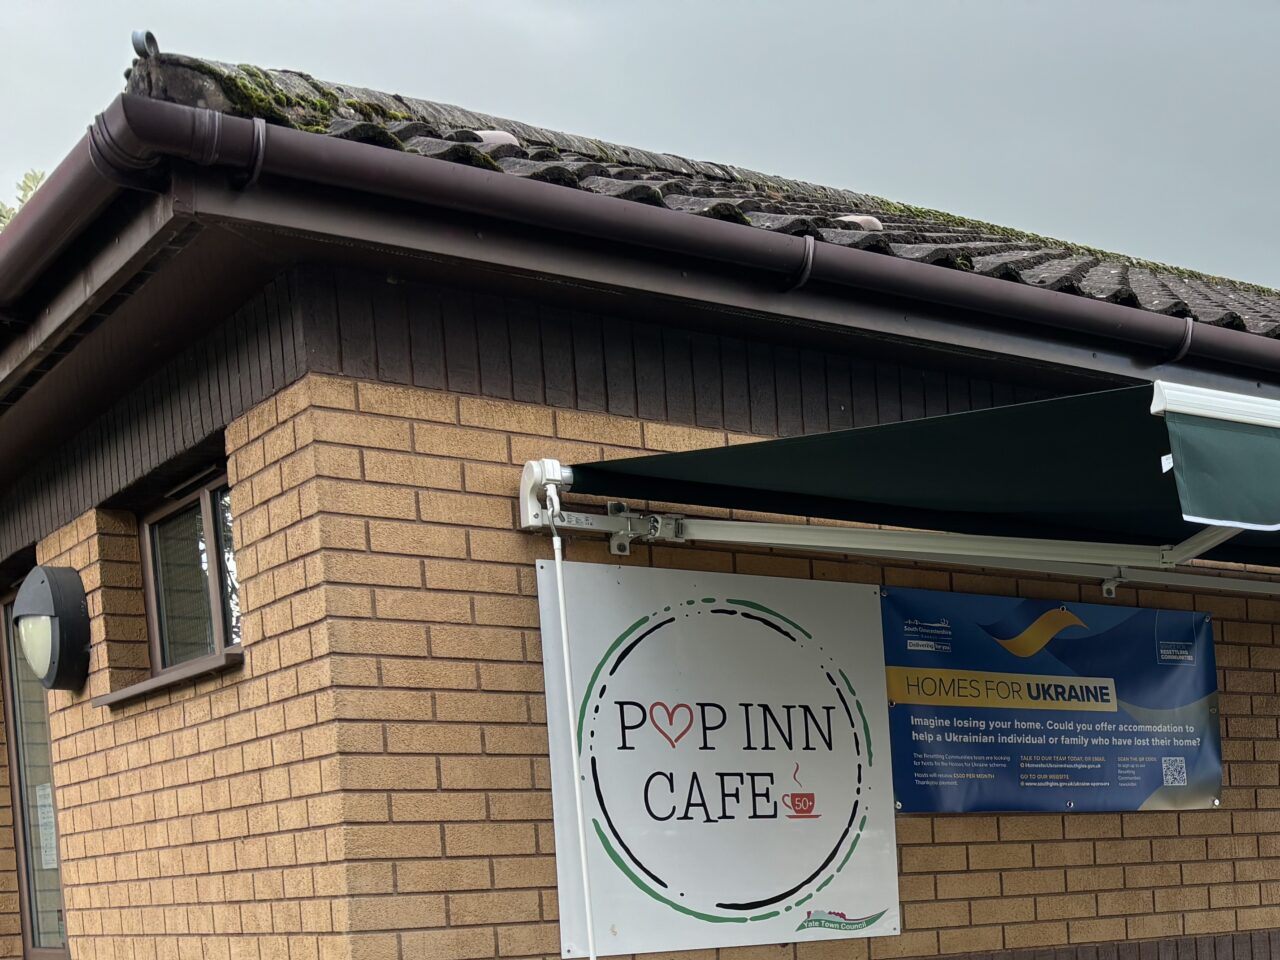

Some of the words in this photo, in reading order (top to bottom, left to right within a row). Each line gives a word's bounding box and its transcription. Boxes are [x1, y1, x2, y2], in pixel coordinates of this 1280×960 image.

[906, 676, 981, 698] HOMES
[985, 680, 1023, 699] FOR
[1026, 683, 1111, 703] UKRAINE
[740, 703, 836, 751] INN
[911, 715, 951, 728] Imagine
[954, 717, 986, 729] losing
[989, 721, 1011, 730] your
[1014, 719, 1044, 730] home.
[1046, 720, 1074, 731] Could
[1076, 723, 1093, 732] you
[1095, 722, 1116, 731] offer
[1119, 723, 1184, 733] accommodation
[1186, 724, 1195, 733] to
[912, 731, 934, 743] help
[936, 734, 942, 742] a
[944, 732, 995, 743] Ukrainian
[998, 733, 1046, 745] individual
[1049, 736, 1058, 745] or
[1061, 735, 1089, 747] family
[1091, 736, 1110, 745] who
[1112, 736, 1132, 746] have
[1134, 737, 1150, 746] lost
[1151, 737, 1171, 746] their
[1173, 737, 1201, 747] home?
[643, 771, 778, 823] CAFE
[795, 797, 813, 810] 50+
[803, 920, 819, 928] Yate
[821, 920, 840, 929] Town
[840, 921, 867, 930] Council
